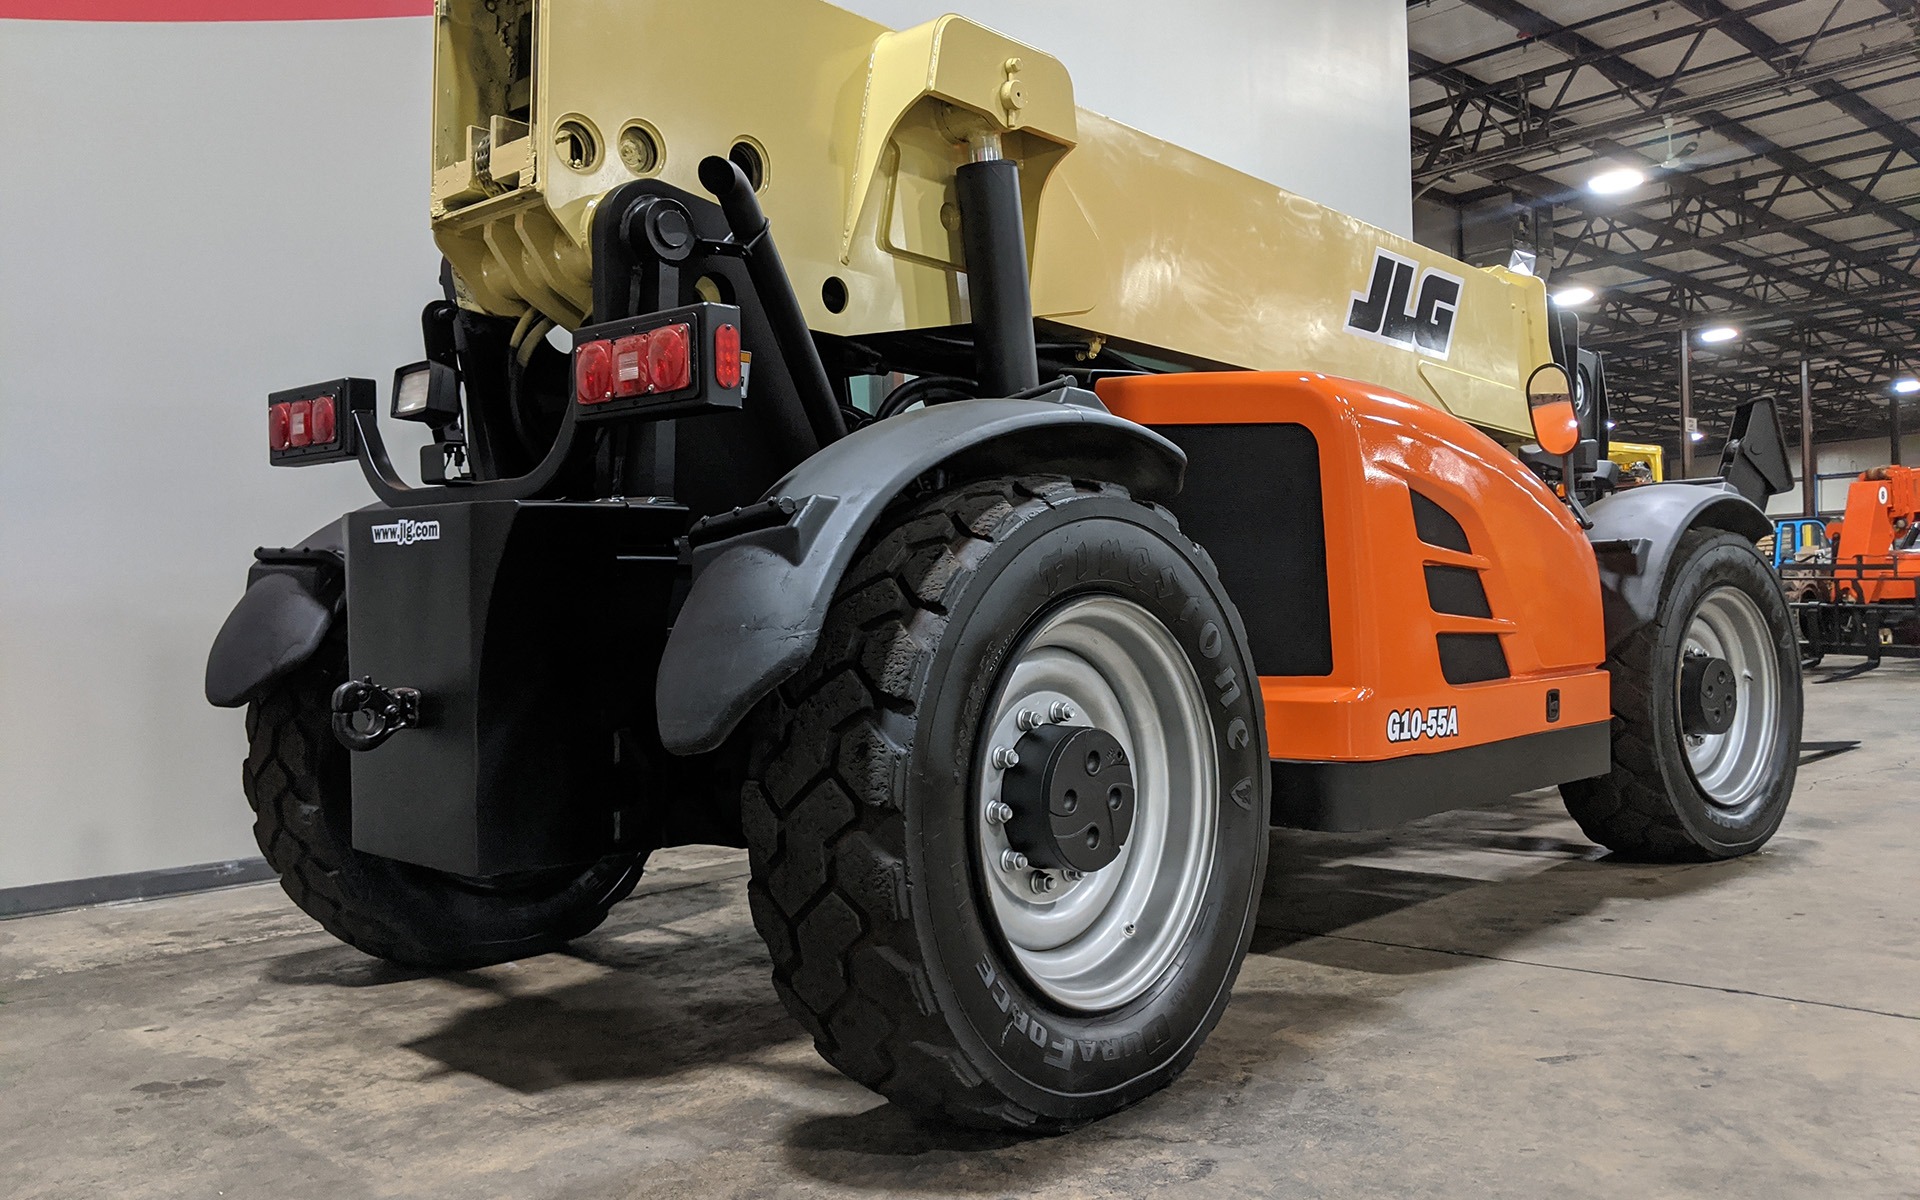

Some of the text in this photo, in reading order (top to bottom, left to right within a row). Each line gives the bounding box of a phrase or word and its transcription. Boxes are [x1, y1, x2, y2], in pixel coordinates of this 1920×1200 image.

[1345, 250, 1463, 358] JLG
[373, 521, 439, 542] www.jlg.com
[1038, 538, 1250, 752] Firestone
[1387, 706, 1459, 742] G10-55A
